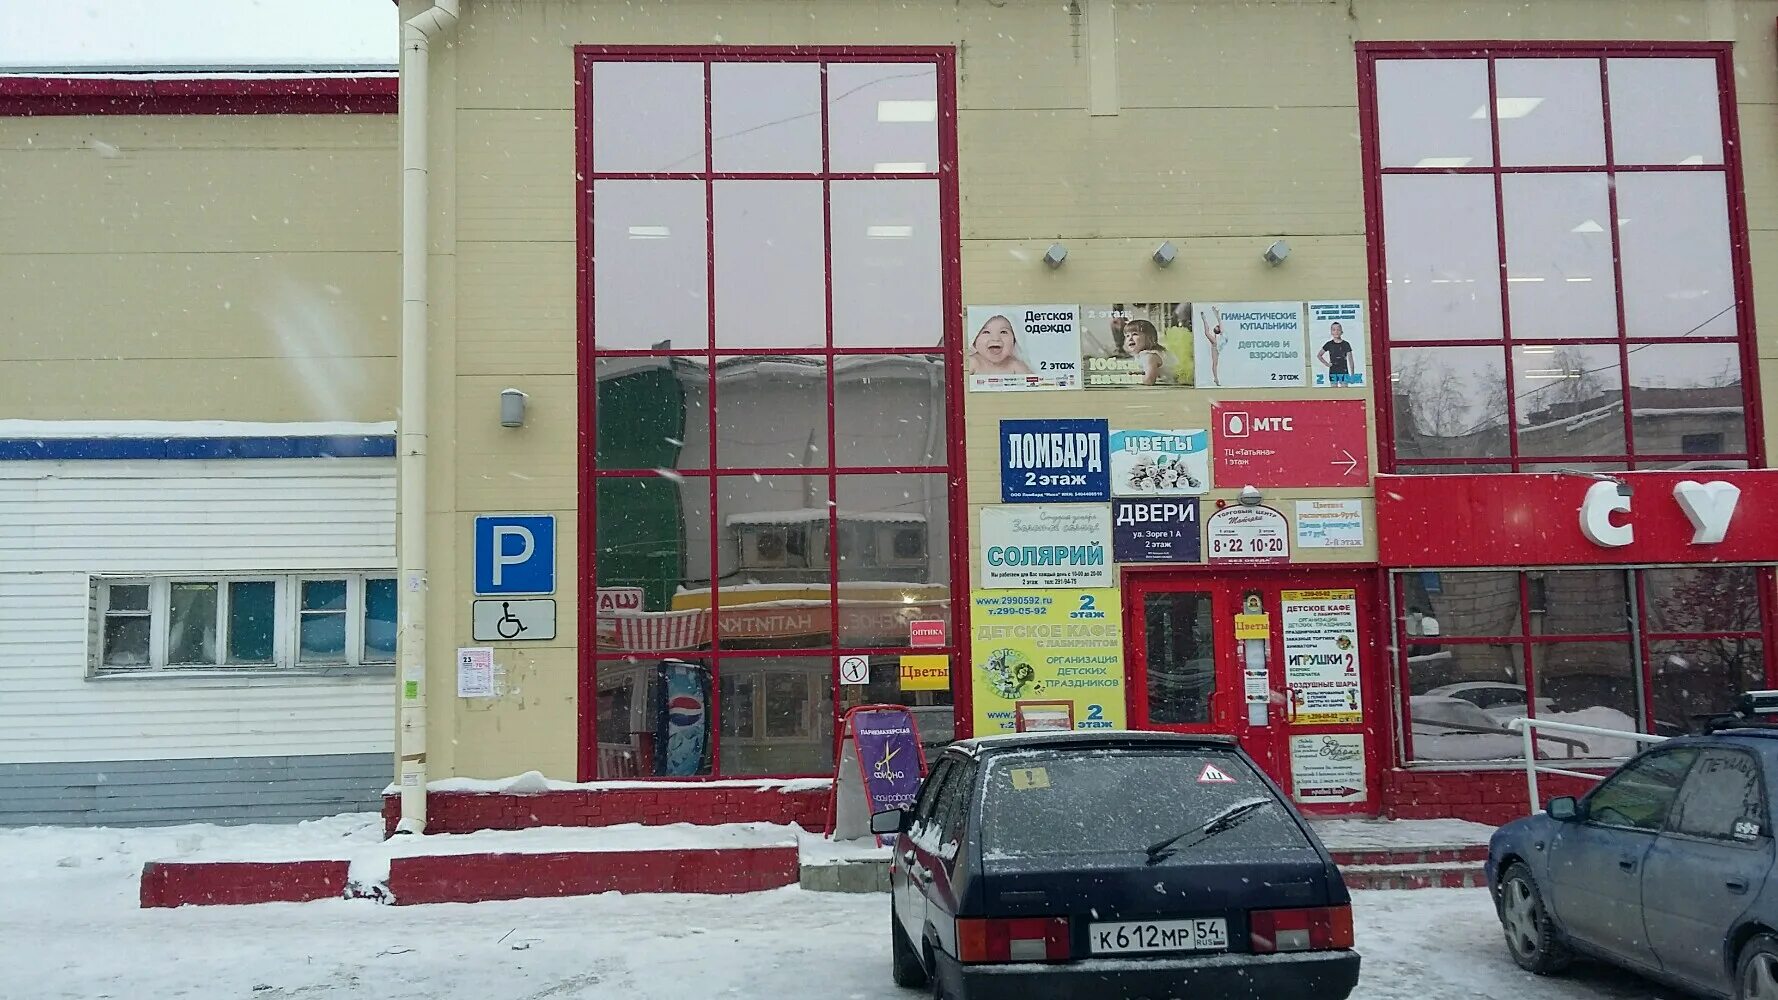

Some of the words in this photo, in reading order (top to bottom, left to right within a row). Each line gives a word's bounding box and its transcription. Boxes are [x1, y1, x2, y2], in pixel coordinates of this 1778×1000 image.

[1025, 311, 1073, 323] Детская
[1025, 324, 1072, 334] одежда
[1238, 341, 1280, 349] детские
[1249, 352, 1298, 360] взрослые
[1041, 361, 1046, 370] 2
[1050, 362, 1075, 370] этаж
[1316, 374, 1324, 384] 2
[1254, 417, 1293, 431] МТС
[1125, 436, 1193, 455] ЦВЕТЫ
[1009, 433, 1102, 472] ЛОМБАРД
[1224, 449, 1234, 457] ТЦ
[1235, 448, 1275, 456] «Татьяна»
[1025, 472, 1037, 486] 2
[1039, 475, 1087, 486] этаж
[1116, 503, 1195, 526] ДВЕРИ
[1217, 509, 1253, 518] ТОРГОВЫЙ
[1256, 510, 1277, 518] ЦЕНТР
[1133, 531, 1145, 539] ул.
[987, 540, 1104, 567] СОЛЯРИЙ
[975, 596, 1053, 605] www.2990592.ru
[1079, 595, 1095, 611] 2
[988, 607, 1047, 615] т.299-05-92
[1287, 605, 1325, 613] ДЕТСКОЕ
[1070, 611, 1105, 619] этаж
[1236, 621, 1269, 631] Цветы
[977, 625, 1064, 640] ДЕТСКОЕ
[1067, 623, 1117, 637] КАФЕ
[1036, 640, 1044, 648] С
[1046, 639, 1118, 648] ЛАБИРИНТОМ
[1046, 655, 1118, 664] ОРГАНИЗАЦИЯ
[1289, 654, 1342, 666] ИГРУШКИ
[1345, 653, 1354, 672] 2
[901, 665, 949, 679] Цветы
[1057, 667, 1106, 676] ДЕТСКИХ
[1045, 679, 1119, 688] ПРАЗДНИКОВ
[1289, 681, 1335, 689] ВОЗДУШНЫЕ
[1087, 704, 1103, 720] 2
[1078, 721, 1113, 729] этаж
[860, 728, 910, 736] ПАРИКМАХЕРСКАЯ
[1206, 772, 1223, 780] Ш
[1196, 921, 1219, 939] 54
